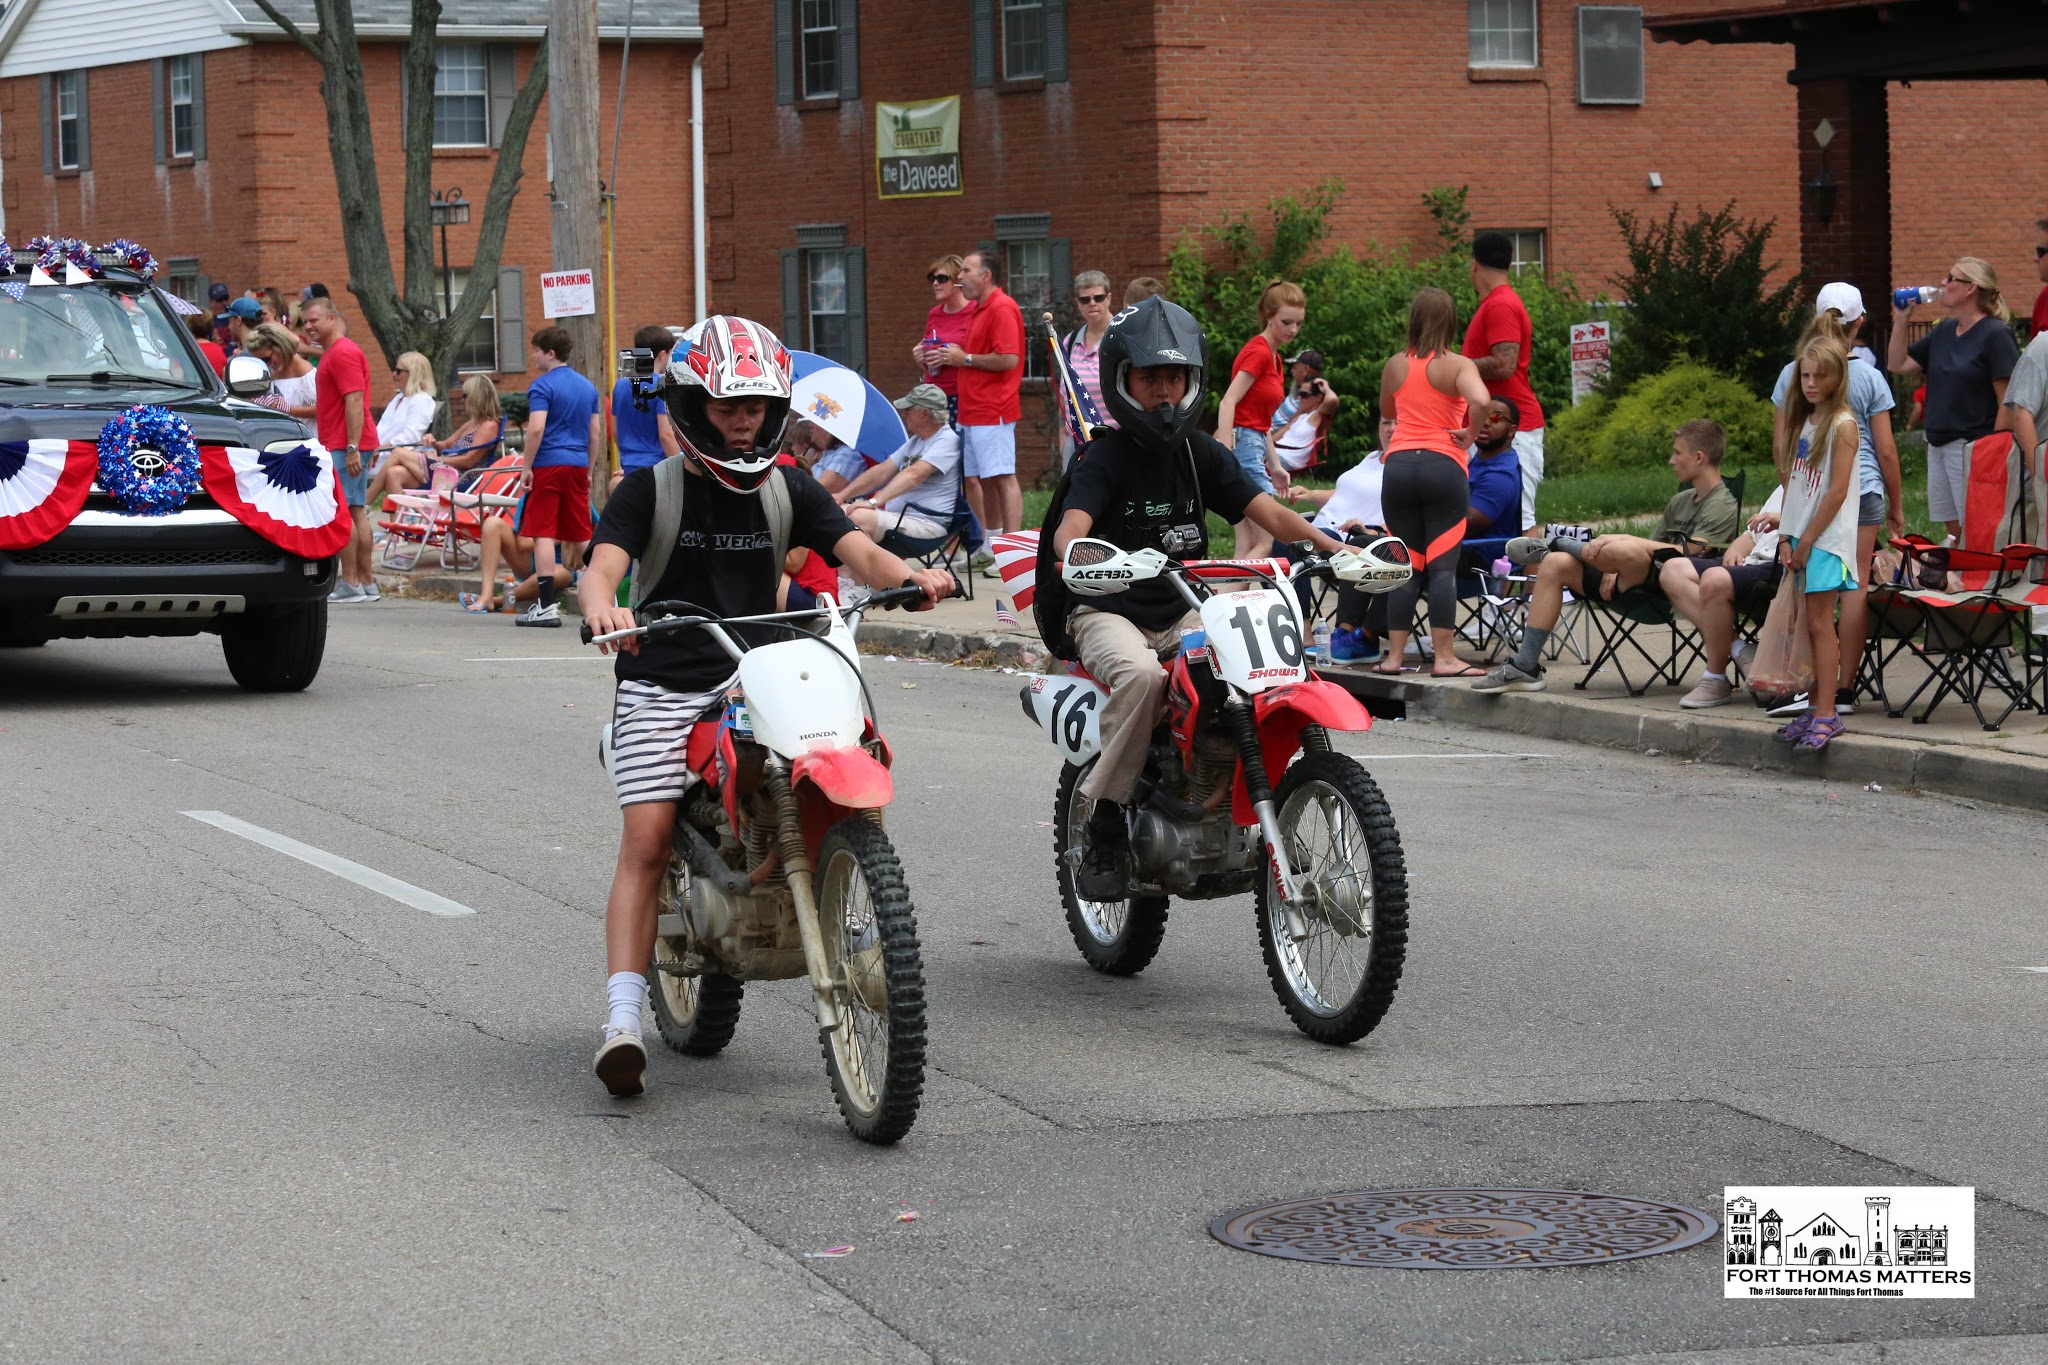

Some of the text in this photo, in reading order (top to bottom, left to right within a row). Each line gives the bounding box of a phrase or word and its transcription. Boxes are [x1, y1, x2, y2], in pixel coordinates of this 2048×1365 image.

[896, 131, 941, 146] COURTYARD
[883, 156, 957, 191] the Daveed
[543, 273, 590, 288] NO PARKING
[1071, 570, 1133, 579] ACERBIS
[1229, 604, 1302, 669] 16
[1247, 668, 1299, 680] SHOWA
[1052, 684, 1096, 752] 16
[799, 730, 838, 740] HONDA
